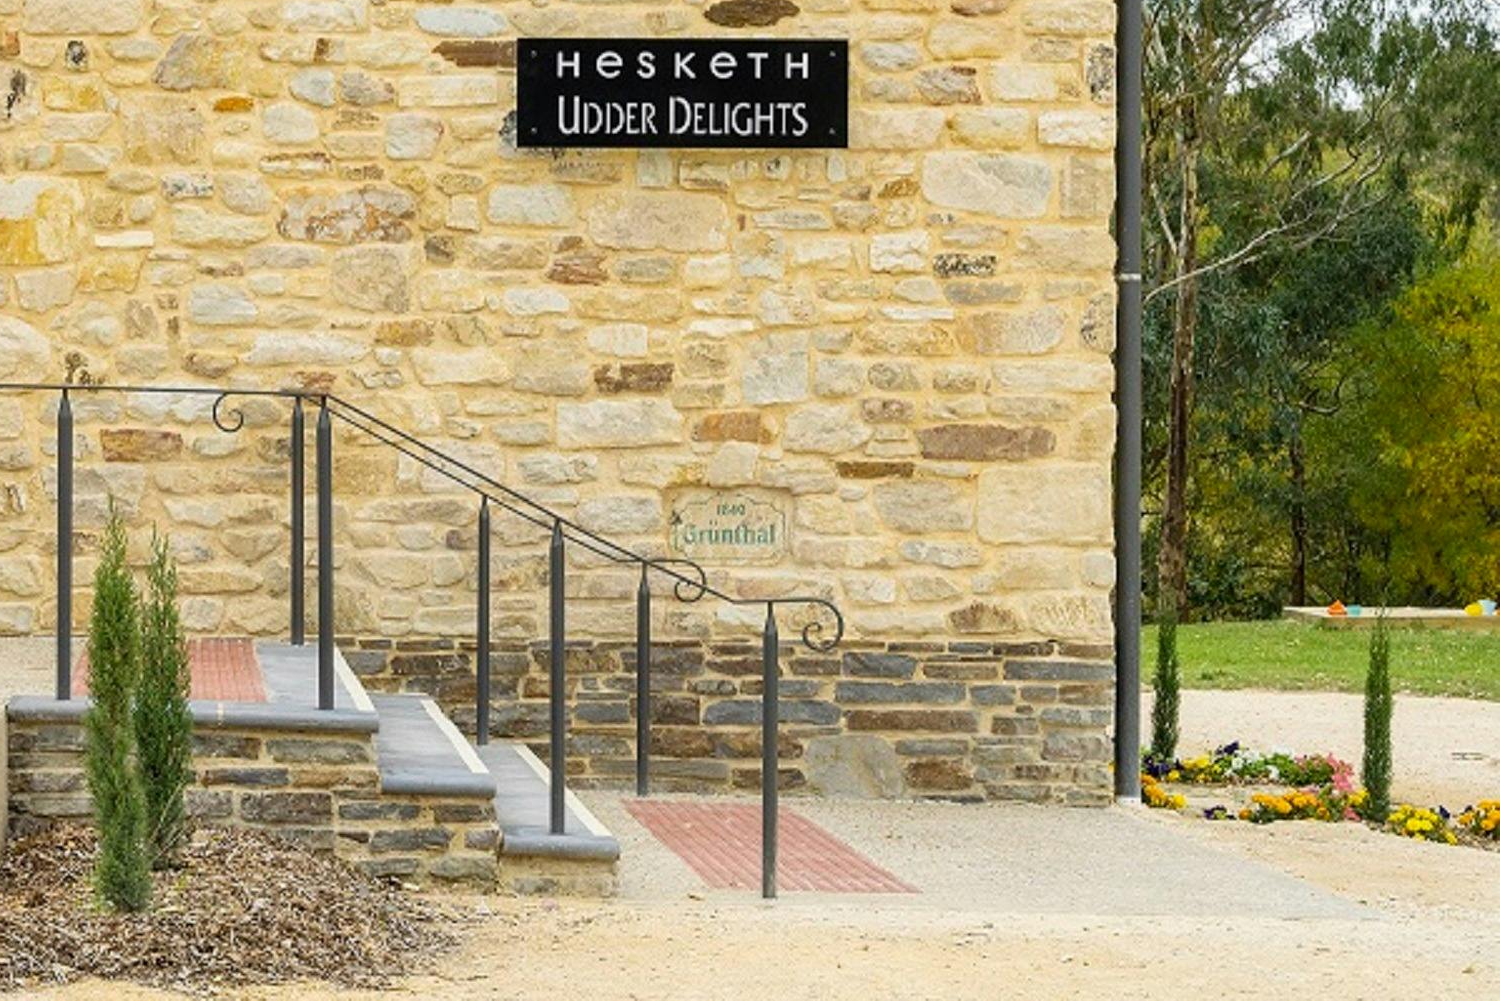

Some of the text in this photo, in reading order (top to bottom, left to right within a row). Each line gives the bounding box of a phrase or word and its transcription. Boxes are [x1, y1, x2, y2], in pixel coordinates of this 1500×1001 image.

[558, 95, 809, 136] UDDER DELIGHTS
[683, 520, 775, 544] Grünthal
